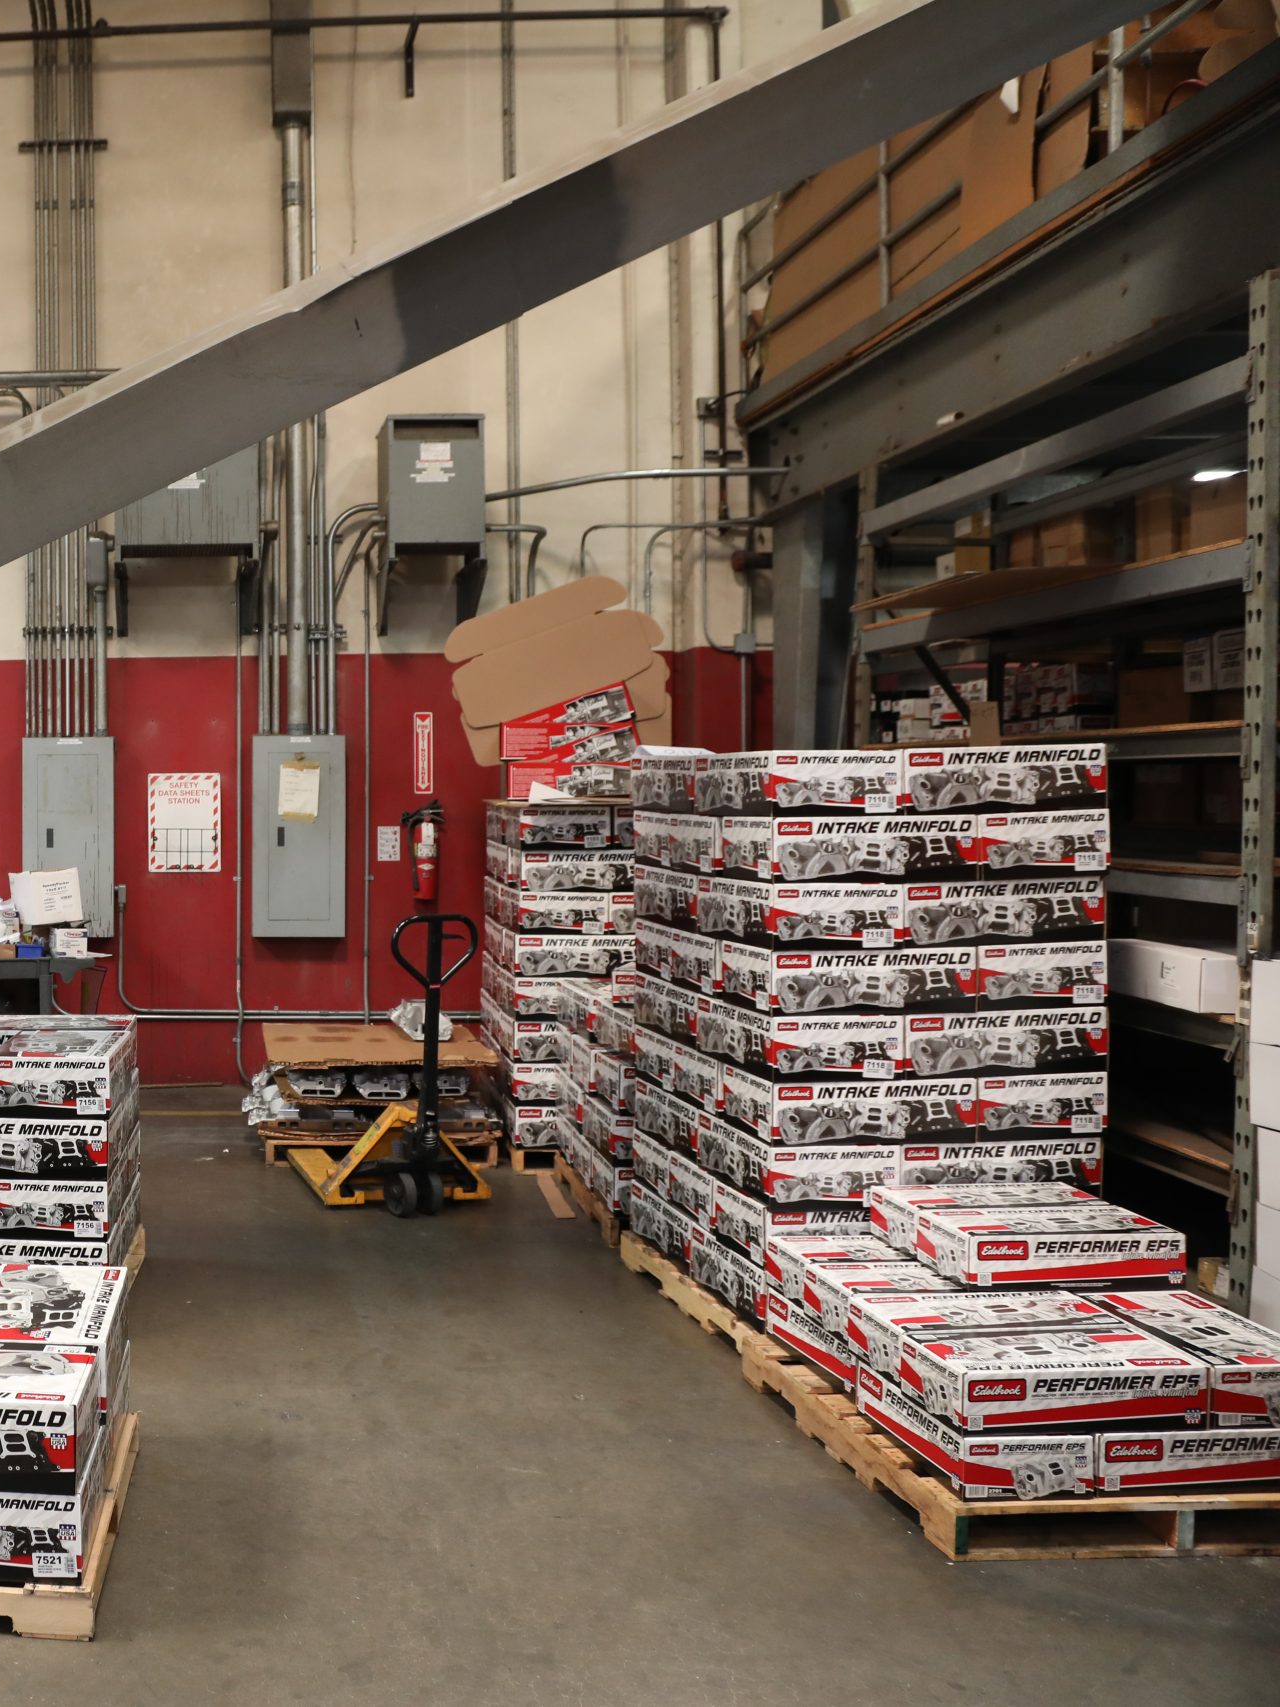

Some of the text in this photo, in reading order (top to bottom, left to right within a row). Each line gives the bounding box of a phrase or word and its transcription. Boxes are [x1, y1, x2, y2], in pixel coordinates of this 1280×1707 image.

[800, 755, 896, 764] INTAKE MANIFOLD
[948, 749, 1101, 765] INTAKE MANIFOLD
[1010, 813, 1105, 825] INTAKE MANIFOLD
[816, 821, 878, 834] INTAKE
[884, 820, 972, 833] MANIFOLD
[552, 853, 636, 862] INTAKE MANIF
[802, 889, 898, 898] INTAKE MANIFOLD
[945, 884, 1008, 898] INTAKE
[1012, 880, 1098, 896] MANIFOLD
[546, 938, 589, 947] INTAKE
[1008, 945, 1102, 957] INTAKE MANIFOLD
[815, 954, 878, 968] INTAKE
[883, 953, 970, 967] MANIFOLD
[1075, 987, 1095, 995] 7118
[801, 1021, 897, 1030] INTAKE MANIFOLD
[948, 1017, 1011, 1030] INTAKE
[1014, 1012, 1101, 1026] MANIFOLD
[866, 1061, 885, 1069] 7118
[1008, 1076, 1103, 1088] INTAKE MANIFOLD
[817, 1086, 880, 1100] INTAKE
[885, 1084, 972, 1098] MANIFOLD
[1074, 1116, 1094, 1124] 7118
[20, 1124, 102, 1136] MANIFOLD
[798, 1151, 894, 1161] INTAKE MANIFOLD
[943, 1146, 1007, 1159] INTAKE
[1011, 1143, 1096, 1157] MANIFOLD
[13, 1184, 103, 1193] INTAKE MANIFOLD
[810, 1211, 870, 1224] INTAKE
[20, 1245, 102, 1259] MANIFOLD
[982, 1240, 1181, 1257] Edelbrock PERFORMER EPS
[706, 1237, 763, 1286] INTAKE MANIFOLD
[84, 1282, 116, 1339] INTAKE MANIFOLD
[790, 1311, 852, 1361] PERFORMER EPS
[997, 1362, 1124, 1370] PERFORMER
[972, 1384, 1021, 1396] Edelbrock
[1033, 1377, 1159, 1392] PERFORMER
[1161, 1374, 1200, 1388] EPS
[861, 1373, 960, 1454] Edelbrock PERFORMER EPS
[52, 1439, 66, 1447] USA
[1110, 1446, 1157, 1457] Edelbrock
[36, 1556, 62, 1565] 7521
